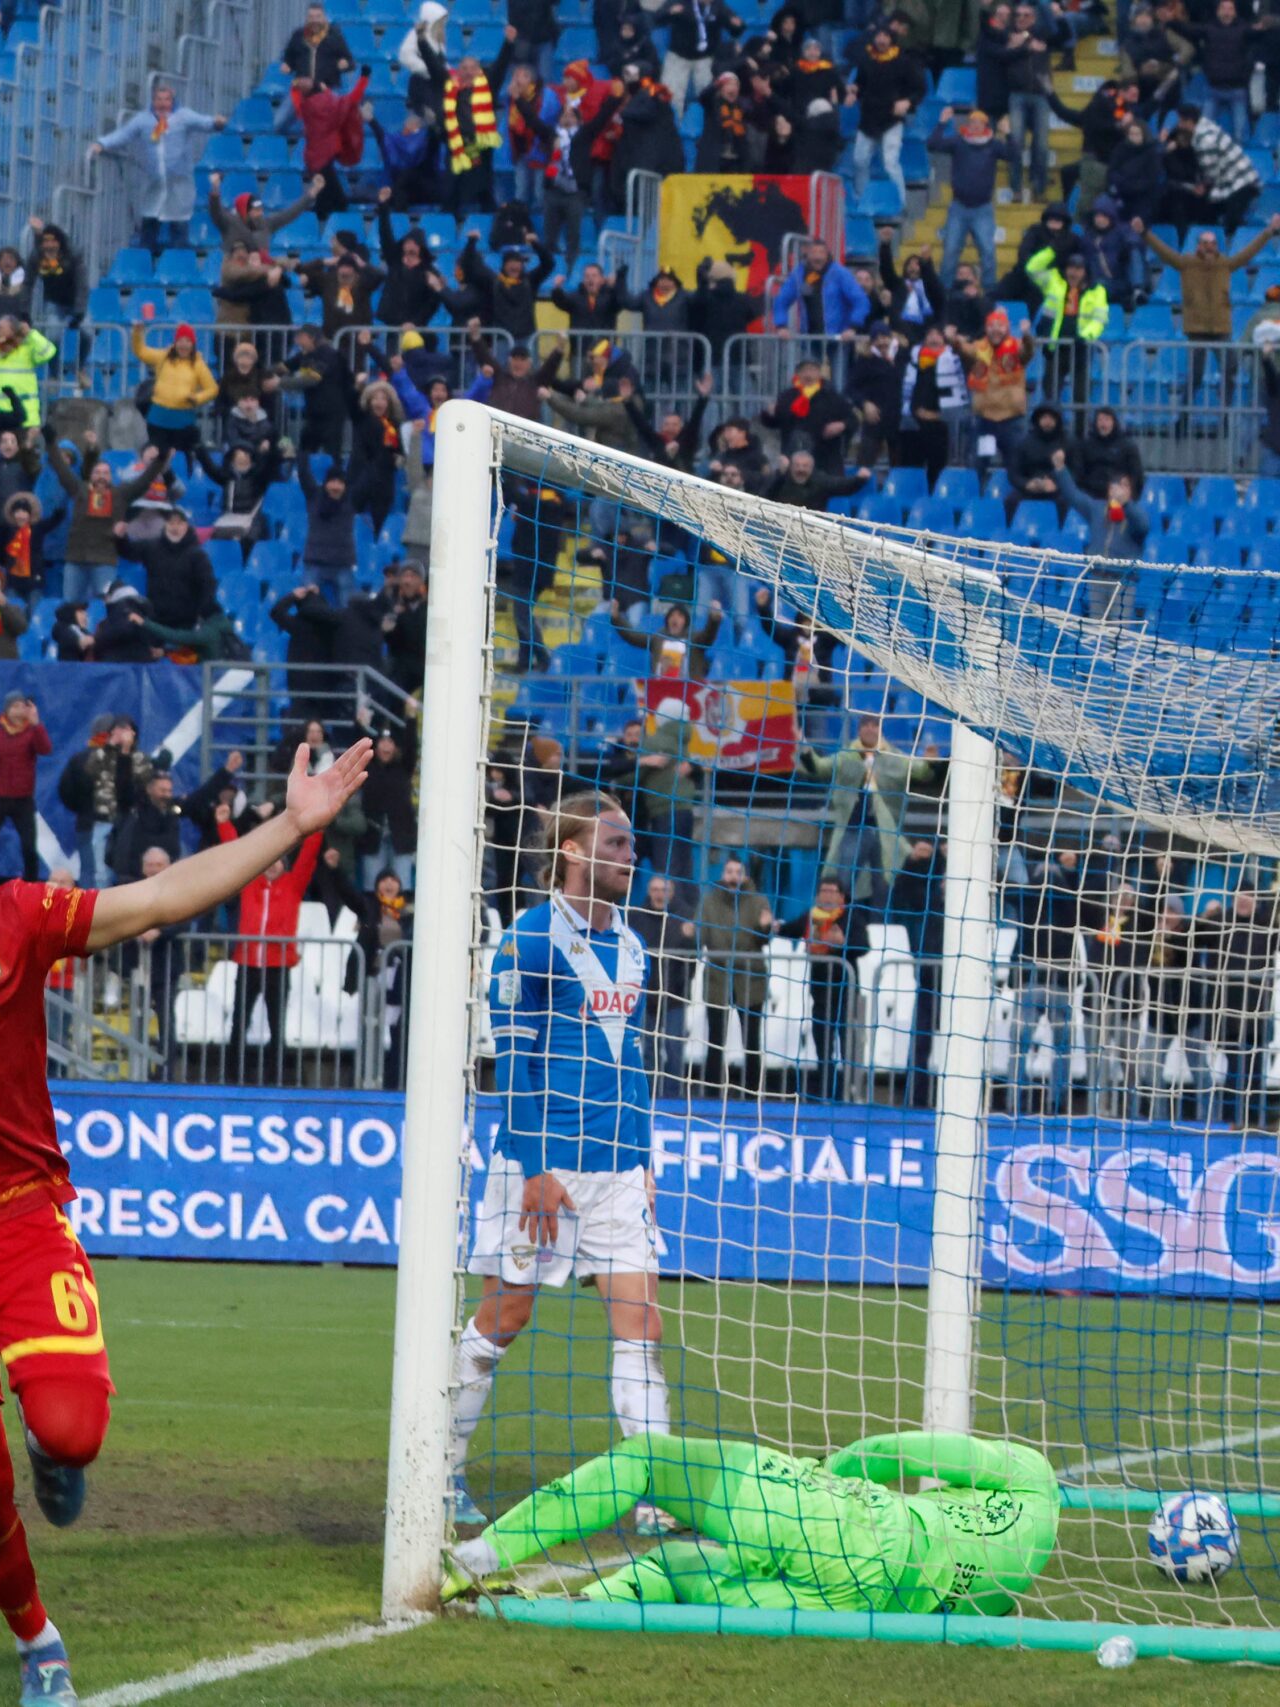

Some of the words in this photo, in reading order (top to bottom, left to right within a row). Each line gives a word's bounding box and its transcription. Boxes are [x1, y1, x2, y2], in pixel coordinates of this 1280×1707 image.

[591, 989, 637, 1015] DAC
[653, 1129, 924, 1188] FFICIALE
[71, 1187, 288, 1242] RESCIA
